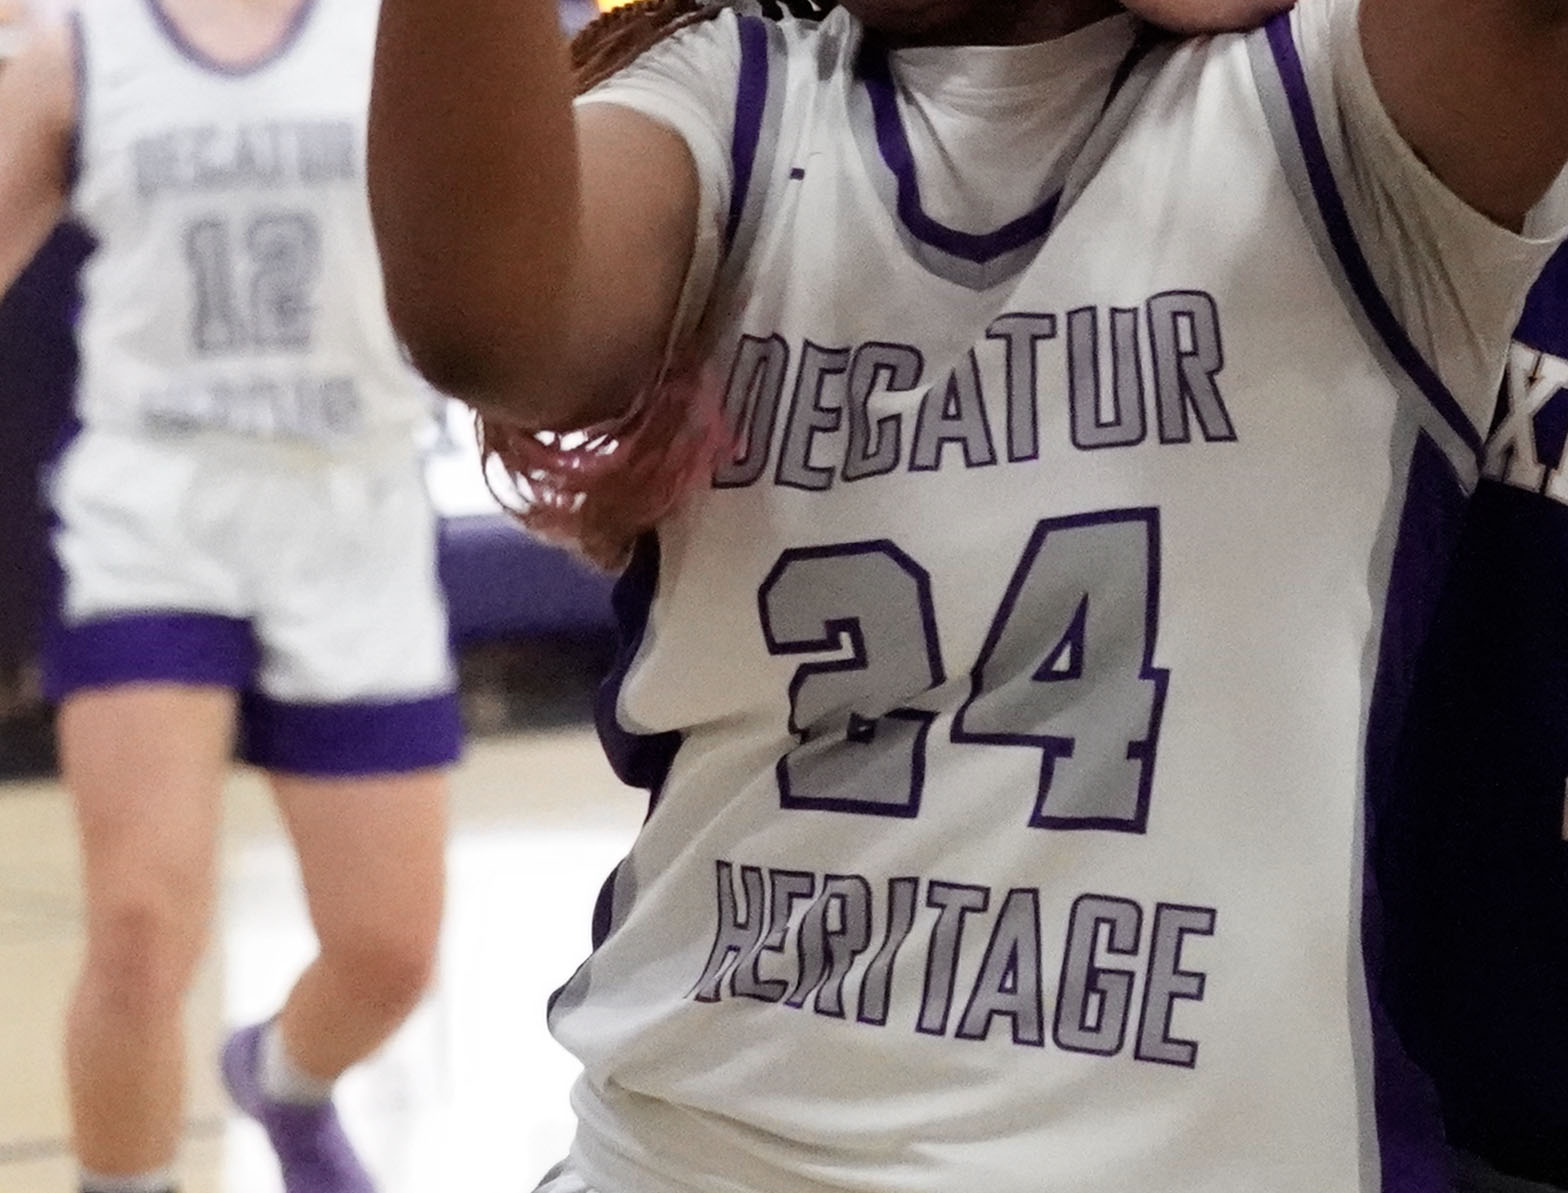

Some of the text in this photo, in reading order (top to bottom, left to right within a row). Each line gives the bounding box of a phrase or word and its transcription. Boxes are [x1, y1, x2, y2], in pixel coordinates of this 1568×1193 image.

[184, 208, 320, 353] 12
[711, 290, 1237, 490] DECATUR
[756, 506, 1170, 834] 24
[692, 859, 1217, 1069] HERITAGE
